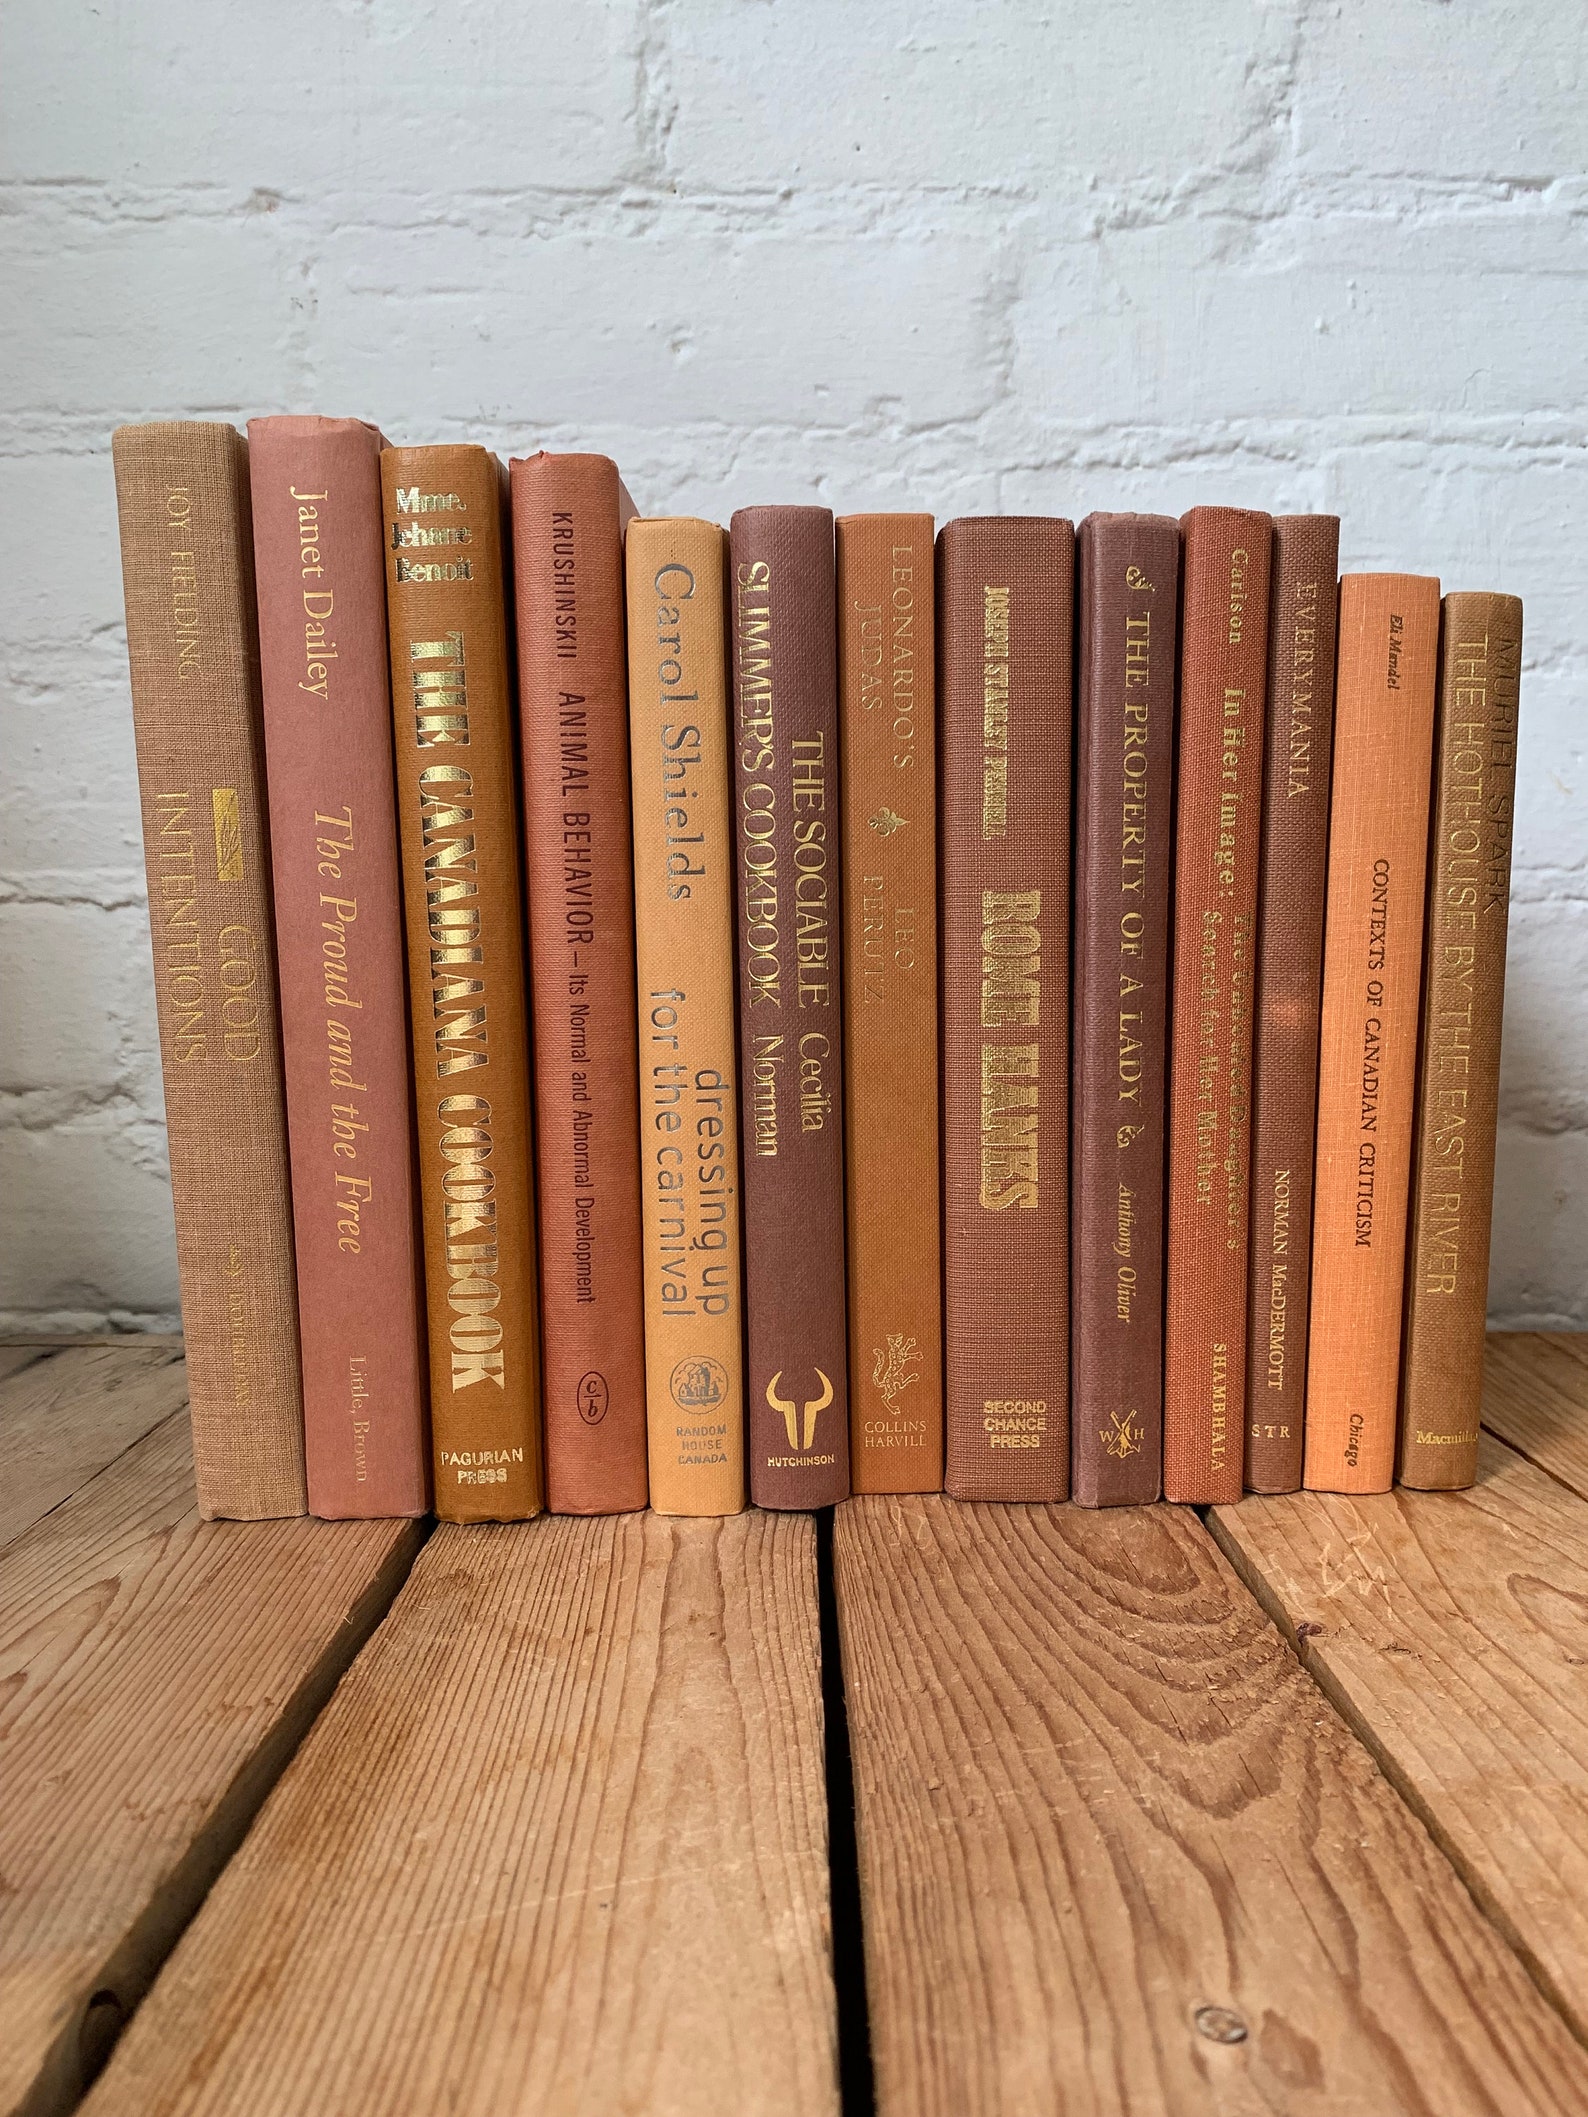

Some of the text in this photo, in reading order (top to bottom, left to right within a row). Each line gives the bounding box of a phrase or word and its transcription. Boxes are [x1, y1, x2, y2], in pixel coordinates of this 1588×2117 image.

[391, 521, 473, 550] Jehane
[396, 486, 467, 514] Mme.
[165, 486, 203, 679] JOY FIELDING
[290, 486, 338, 700] Janet Dailey
[396, 556, 474, 582] Benoit
[552, 512, 577, 659] KRUSHINSKII
[983, 585, 1009, 657] JOSEPH
[1229, 547, 1248, 644] Carlson
[410, 631, 470, 748] THE
[854, 599, 883, 711] JUDAS
[891, 545, 914, 769] LEONARDO'S
[983, 662, 1009, 750] STANLEY
[1287, 581, 1317, 798] EVERYMANIA
[1387, 614, 1403, 690] Eli Mandel
[558, 691, 589, 797] ANIMAL
[654, 562, 707, 901] Carol Shields
[737, 561, 782, 1009] SLIMMER'S COOKBOOK
[1484, 640, 1519, 916] MURIEL SPARK
[1214, 689, 1246, 897] In Her Image:
[563, 812, 596, 943] BEHAVIOR
[792, 731, 830, 1009] THE SOCIABLE
[1118, 611, 1150, 1106] THE PROPERTY OF A LADY
[156, 792, 208, 1062] INTENTIONS
[417, 765, 491, 1080] CANADIANA
[862, 876, 884, 1005] PERUTZ
[894, 906, 915, 970] LEO
[980, 889, 1041, 1027] ROME
[1426, 633, 1489, 1295] THE HOTHOUSE BY THE EAST RIVER
[218, 924, 263, 1061] GOOD
[314, 805, 373, 1255] The Proud and the Free
[568, 974, 586, 995] Its
[569, 1004, 592, 1063] Normal
[571, 1073, 593, 1101] and
[752, 1033, 785, 1157] Norman
[799, 1032, 833, 1132] Cecilia
[1196, 911, 1223, 1206] Search for Her Mother
[1355, 858, 1390, 1247] CONTEXTS OF CANADIAN CRITICISM
[573, 1111, 594, 1188] Abnormal
[650, 987, 697, 1316] for the carnival
[689, 1066, 734, 1317] dressing up
[574, 1198, 598, 1303] Development
[1111, 1183, 1137, 1322] Anthony Oliver
[1268, 1169, 1290, 1390] NORMAN MacDERMOTT
[349, 1357, 371, 1482] Little, Brown
[441, 1447, 523, 1466] PAGURIAN
[676, 1424, 727, 1437] RANDOM
[678, 1453, 728, 1465] CANADA
[682, 1439, 722, 1451] HOUSE
[766, 1453, 835, 1468] HUTCHINSON
[864, 1420, 927, 1433] COLLINS
[865, 1434, 927, 1448] HARVILL
[983, 1400, 1046, 1415] SECOND
[983, 1417, 1047, 1431] CHANCE
[990, 1433, 1040, 1448] PRESS
[1210, 1342, 1227, 1471] SHAMBHALA
[1343, 1413, 1364, 1467] Chicago
[1416, 1430, 1478, 1444] Macmilla
[457, 1467, 508, 1485] PRESS
